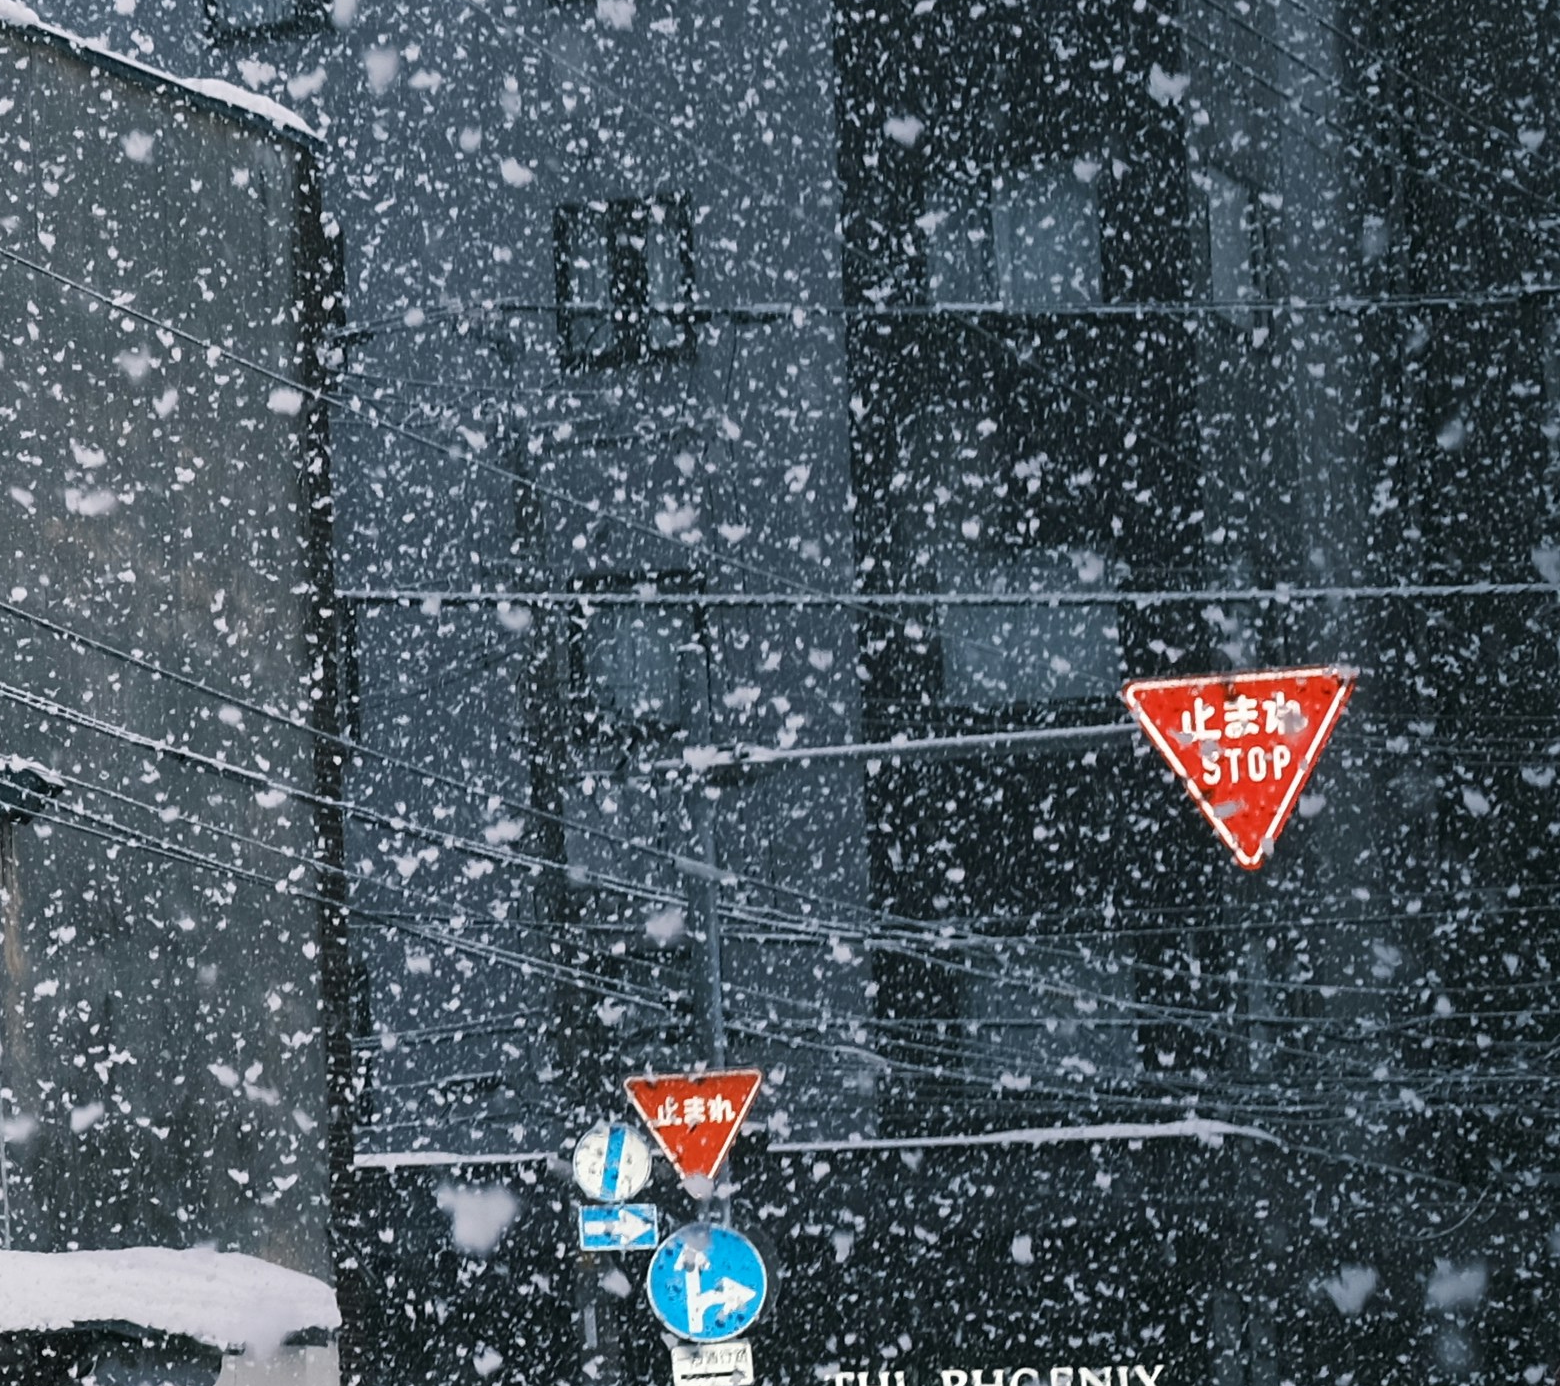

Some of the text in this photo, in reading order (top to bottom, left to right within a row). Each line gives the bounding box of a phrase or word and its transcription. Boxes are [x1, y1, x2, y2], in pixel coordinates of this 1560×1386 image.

[1178, 691, 1309, 741] 止まれ
[1200, 744, 1291, 785] STOP
[654, 1093, 736, 1126] 止まれ
